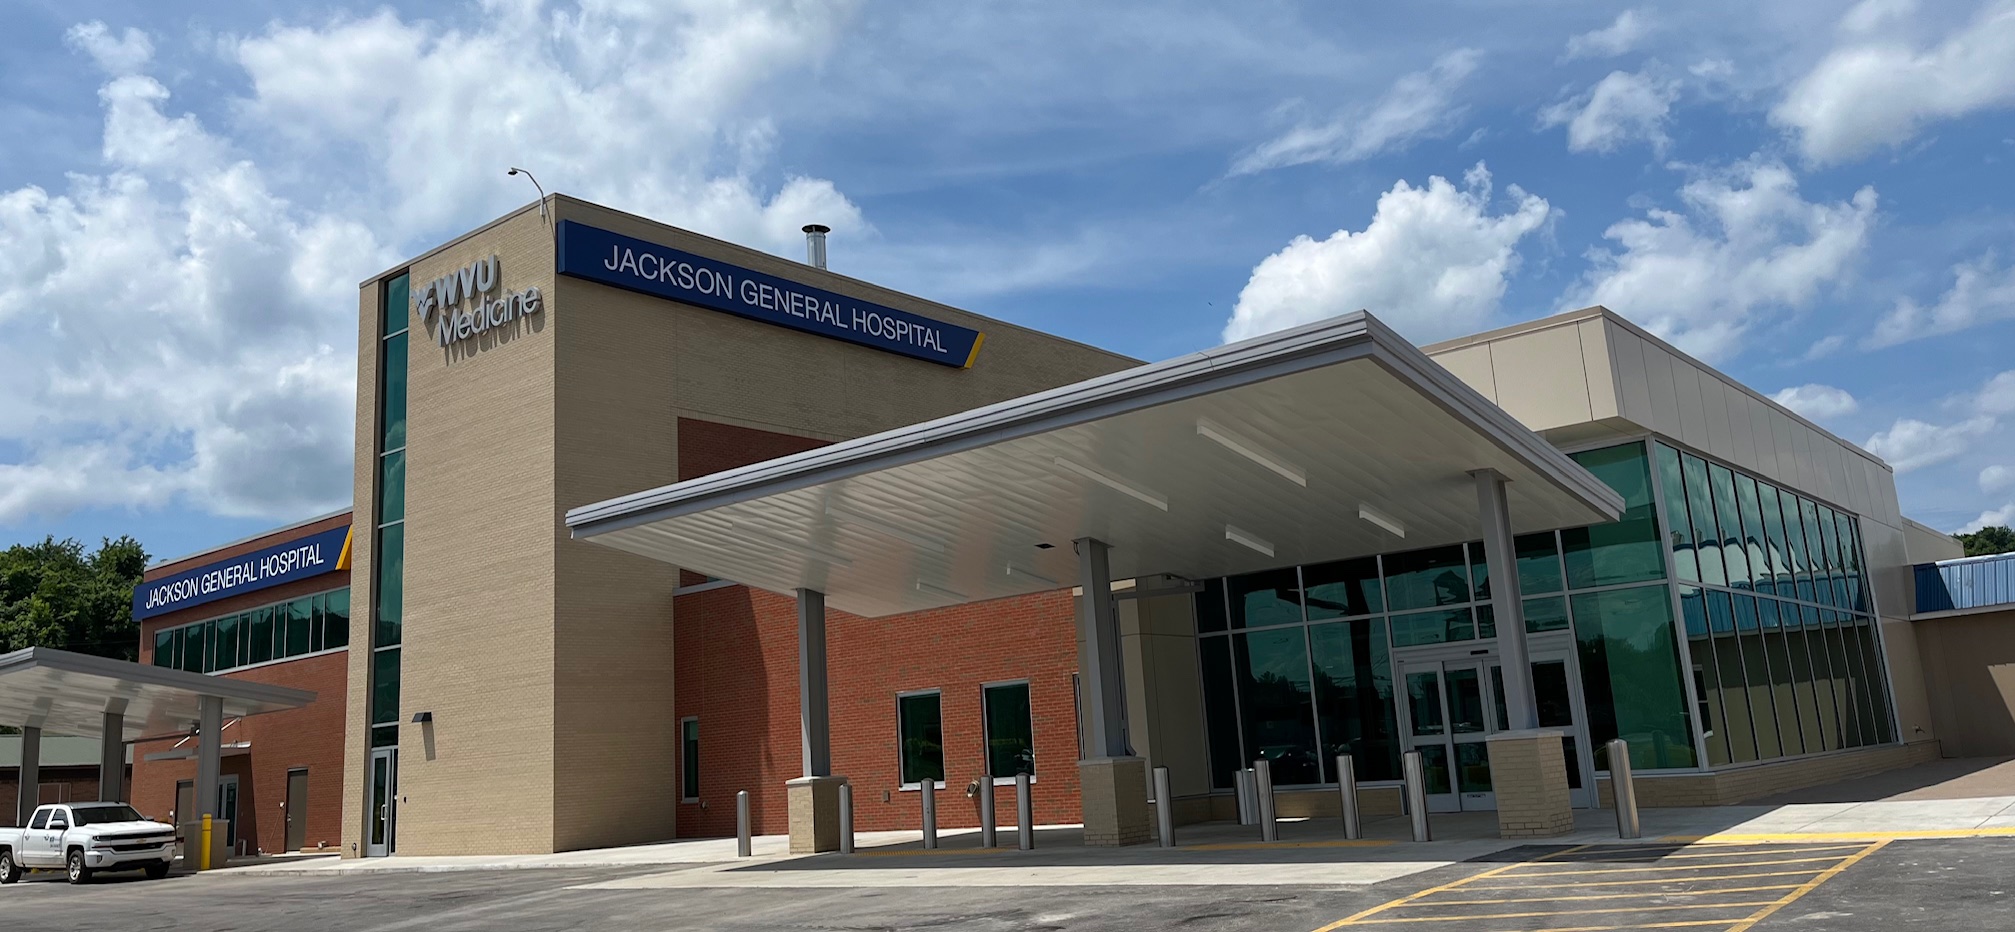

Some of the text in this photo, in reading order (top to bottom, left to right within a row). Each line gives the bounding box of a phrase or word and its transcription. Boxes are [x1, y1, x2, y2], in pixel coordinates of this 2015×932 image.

[435, 254, 498, 309] WVU
[603, 244, 948, 354] JACKSON GENERAL HOSPITAL
[439, 286, 540, 347] Medicine
[146, 543, 324, 609] JACKSON GENERAL HOSPITAL
